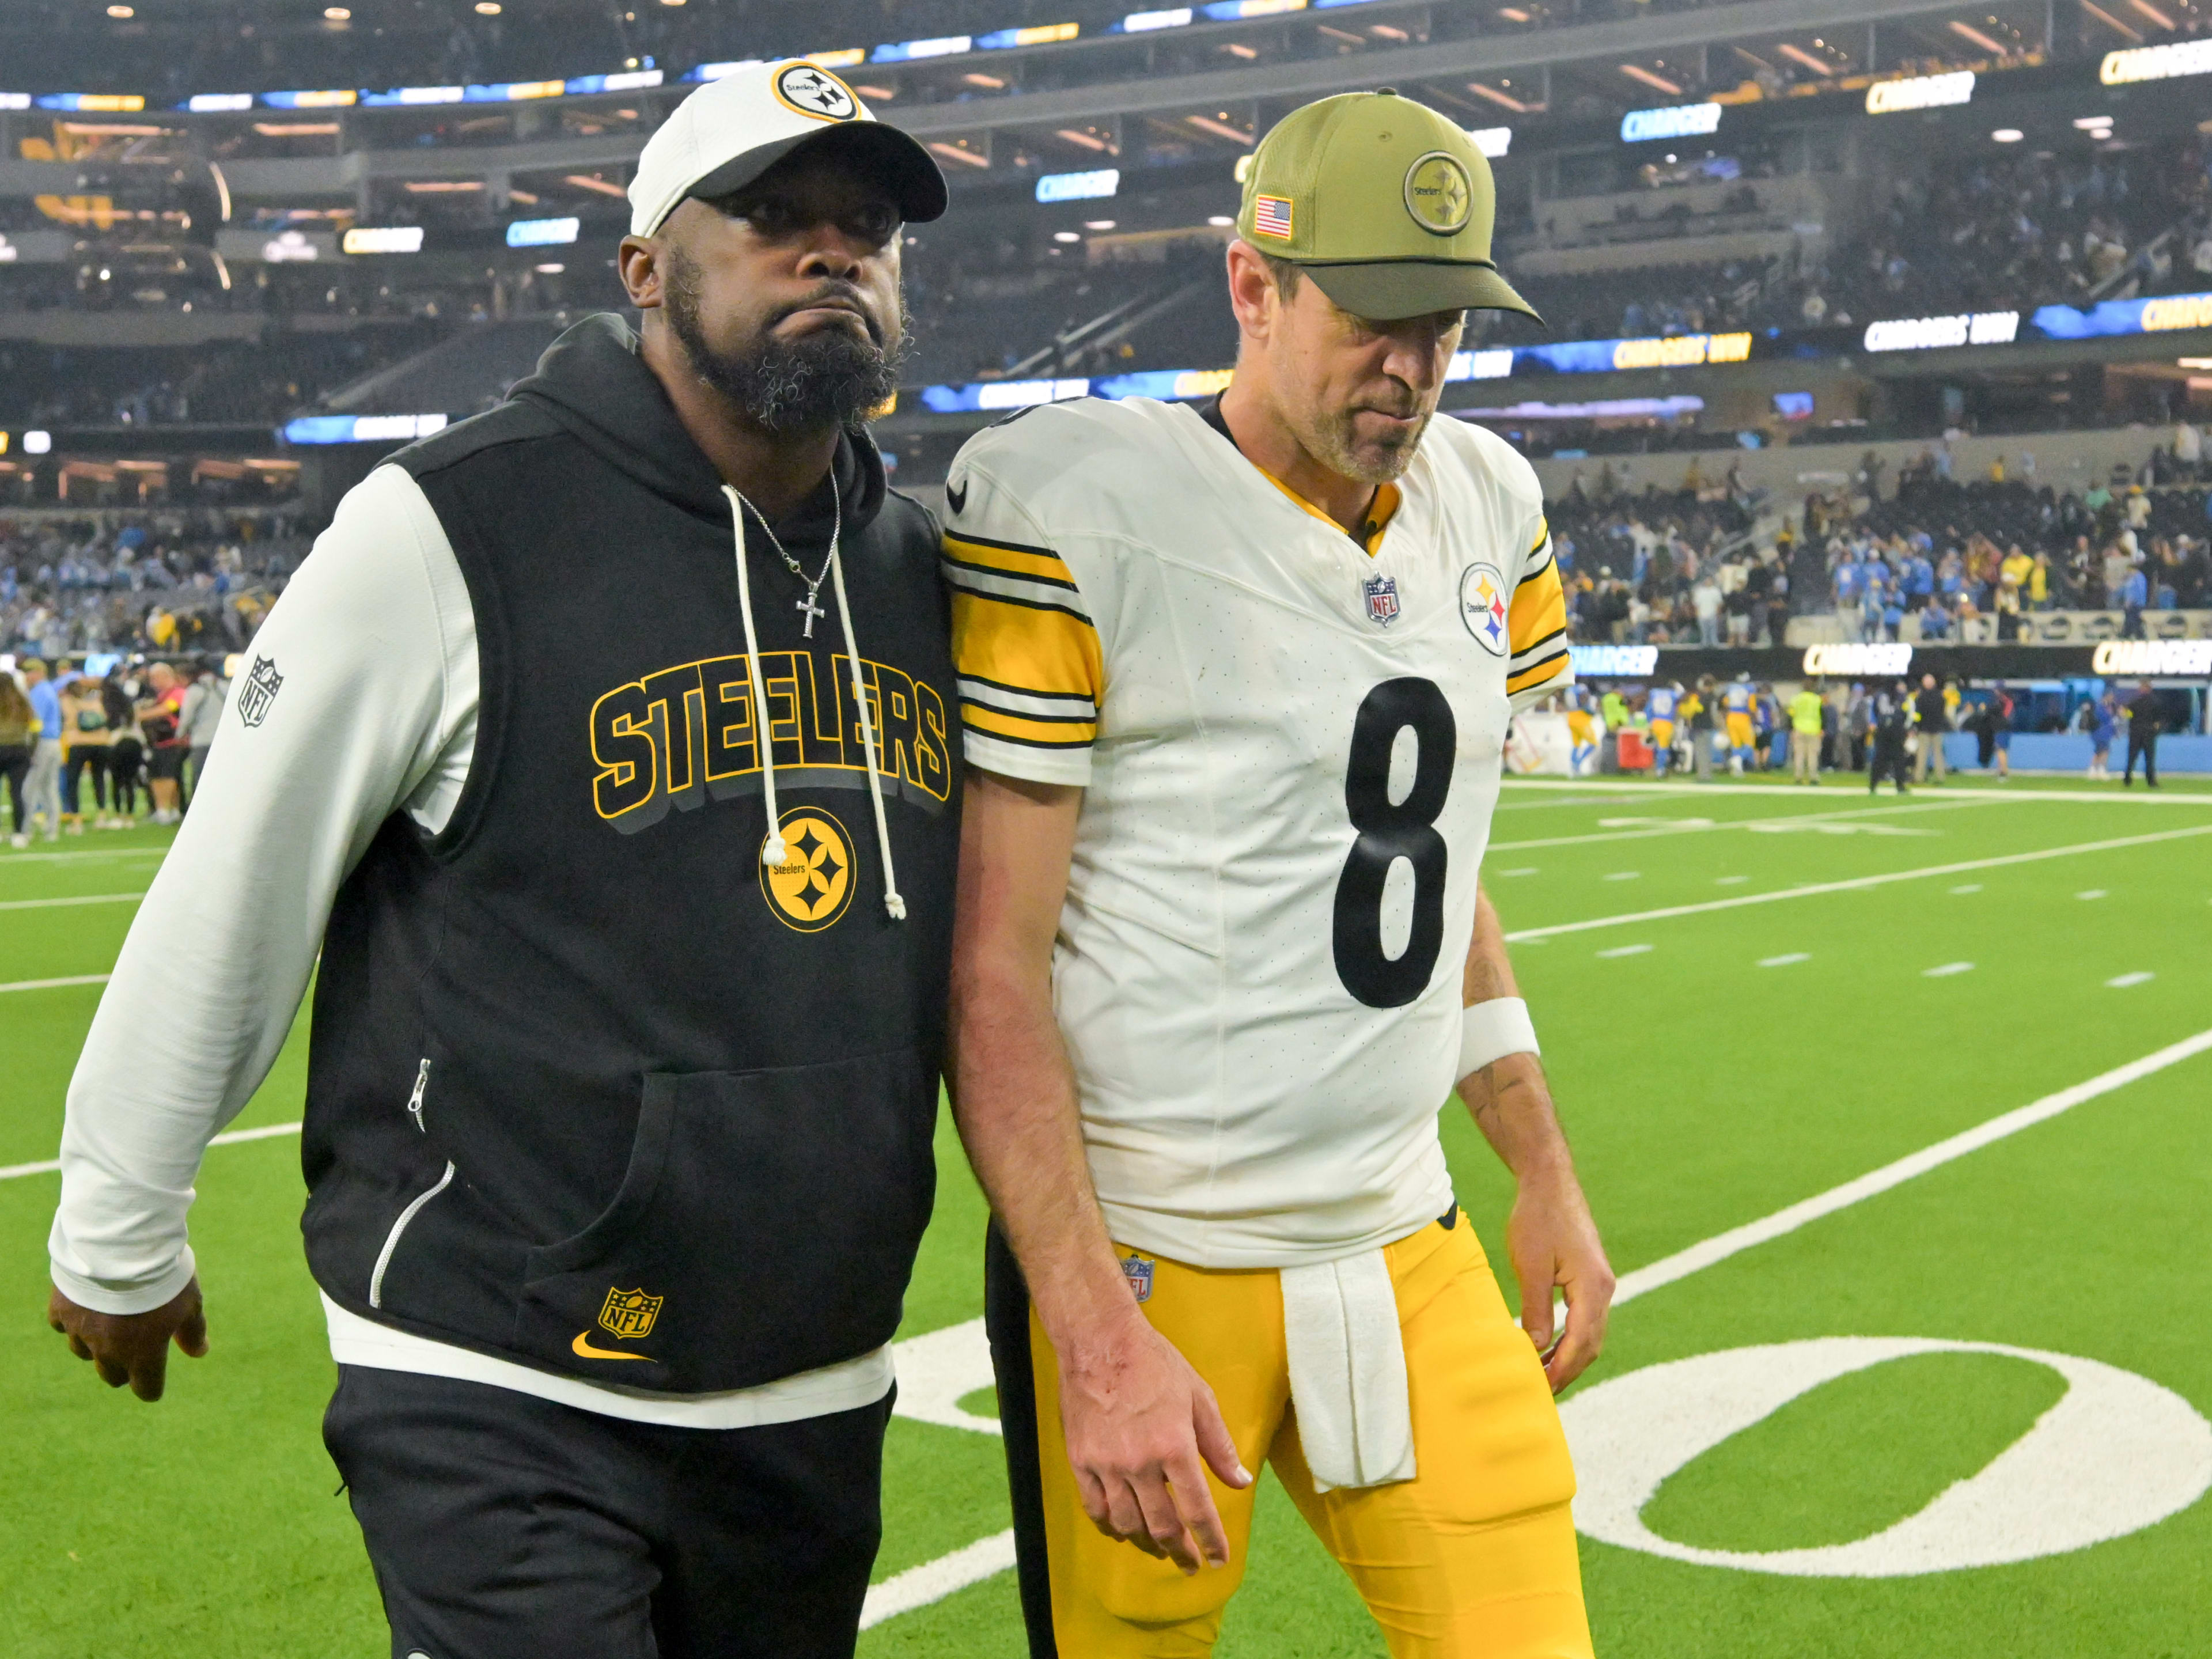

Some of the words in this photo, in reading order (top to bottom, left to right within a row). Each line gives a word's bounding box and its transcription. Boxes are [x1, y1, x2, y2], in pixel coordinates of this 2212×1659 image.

[786, 84, 820, 92] Steelers
[1414, 187, 1441, 196] Steelers
[1372, 594, 1397, 616] NFL
[1467, 602, 1488, 613] Steelers
[241, 679, 269, 722] NFL
[591, 651, 950, 820] STEELERS
[1333, 677, 1456, 1009] 8
[773, 863, 806, 875] Steelers
[605, 1307, 647, 1334] NFL
